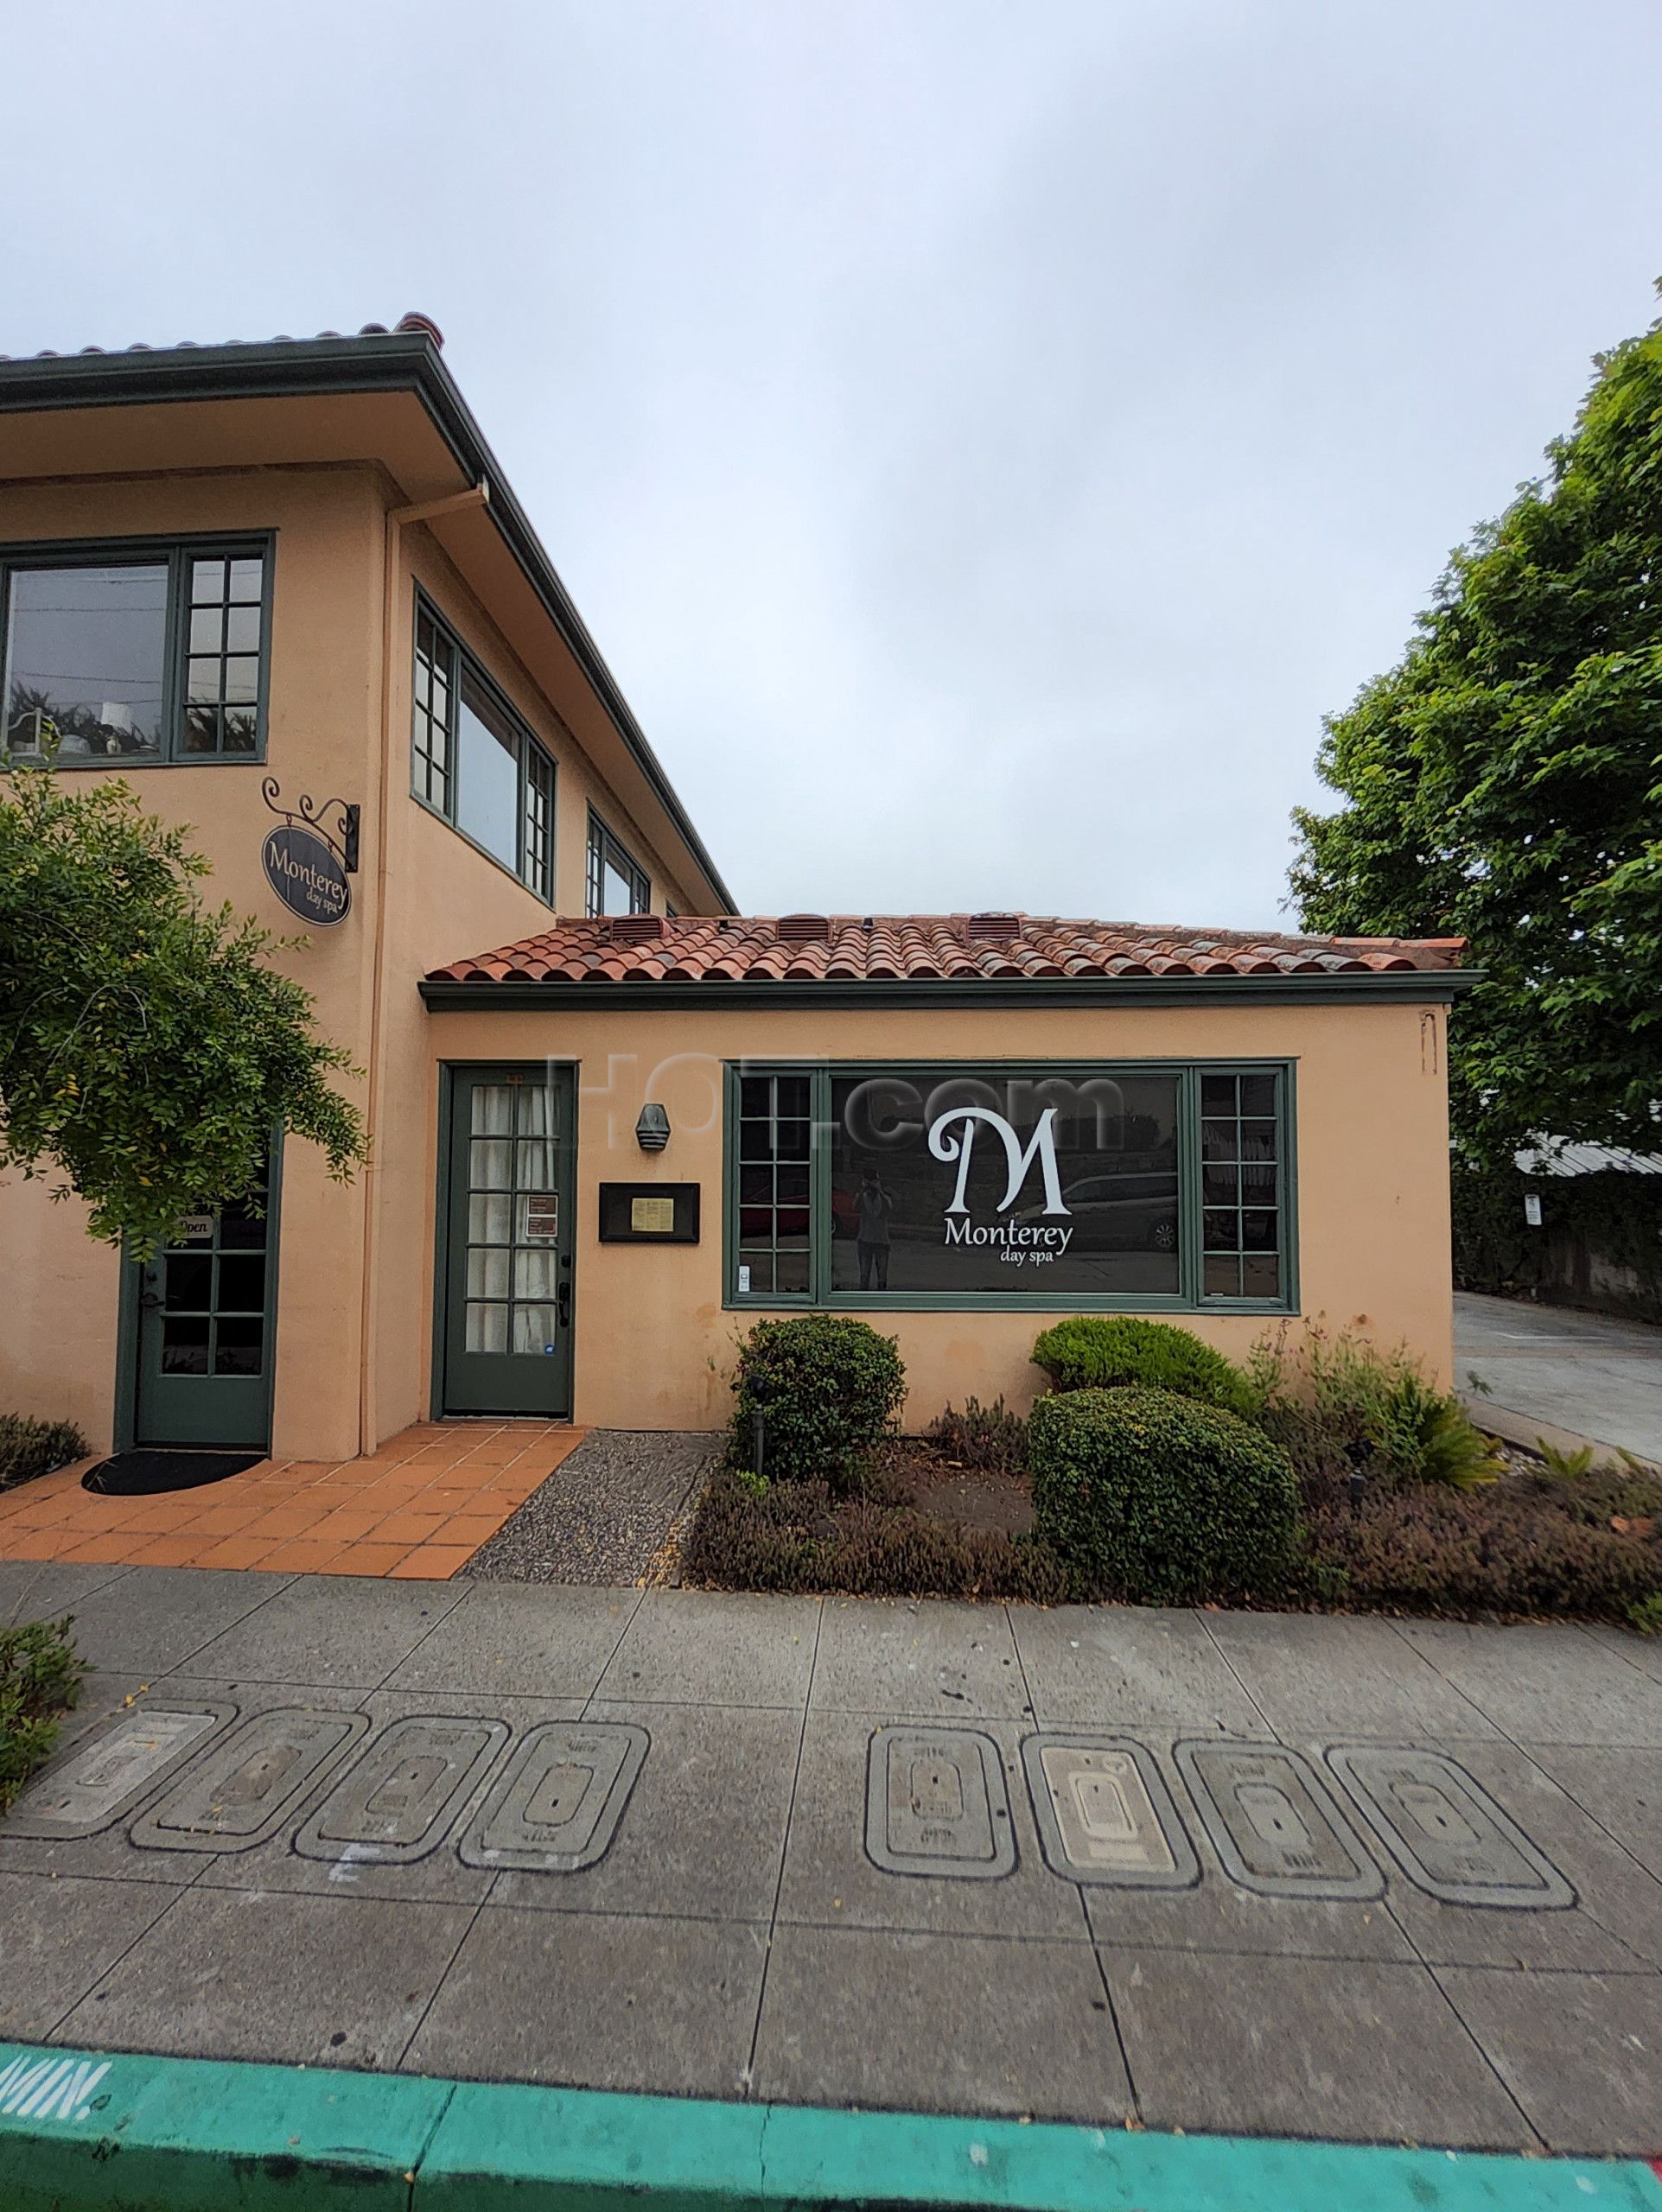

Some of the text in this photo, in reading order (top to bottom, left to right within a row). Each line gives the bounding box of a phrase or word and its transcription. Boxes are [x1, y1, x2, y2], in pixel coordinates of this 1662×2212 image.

[270, 841, 347, 910] Monterey
[306, 887, 338, 915] day spa
[928, 1107, 1073, 1216] M
[944, 1217, 1073, 1255] Monterey
[1000, 1244, 1054, 1267] day spa
